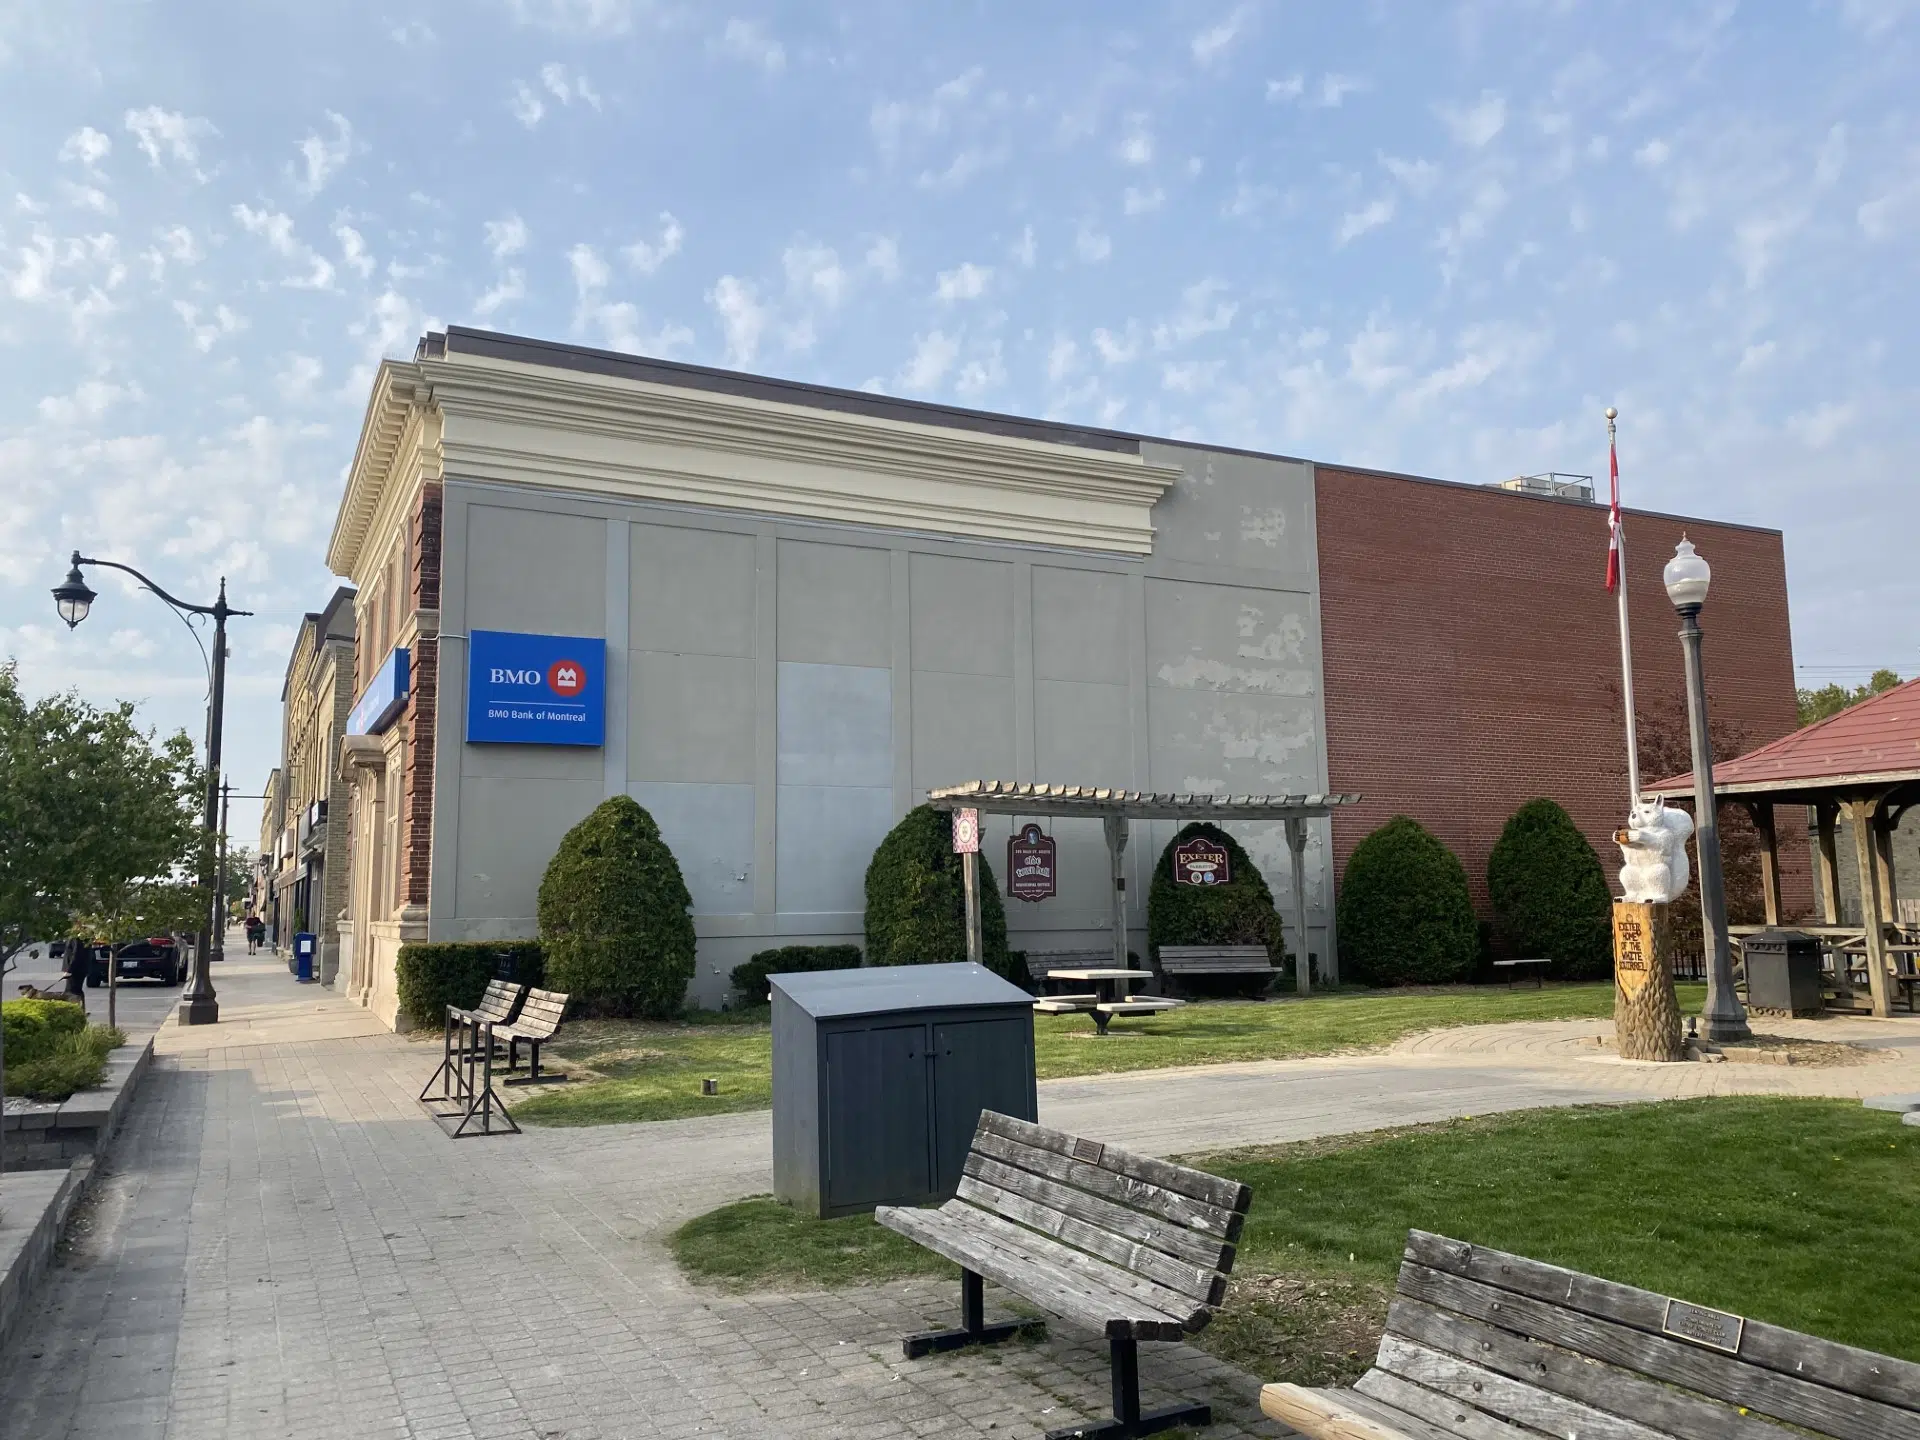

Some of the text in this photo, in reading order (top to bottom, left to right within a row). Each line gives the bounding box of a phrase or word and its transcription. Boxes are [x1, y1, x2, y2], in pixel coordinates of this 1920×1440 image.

[489, 668, 541, 685] BMO
[488, 709, 586, 722] BMO Bank of Montreal
[1179, 853, 1224, 864] EXETER
[1618, 922, 1641, 933] EXETER
[1623, 932, 1638, 941] HOME
[1621, 941, 1642, 951] OF THE
[1622, 951, 1643, 961] WHITE
[1619, 961, 1647, 972] SQUIRREL
